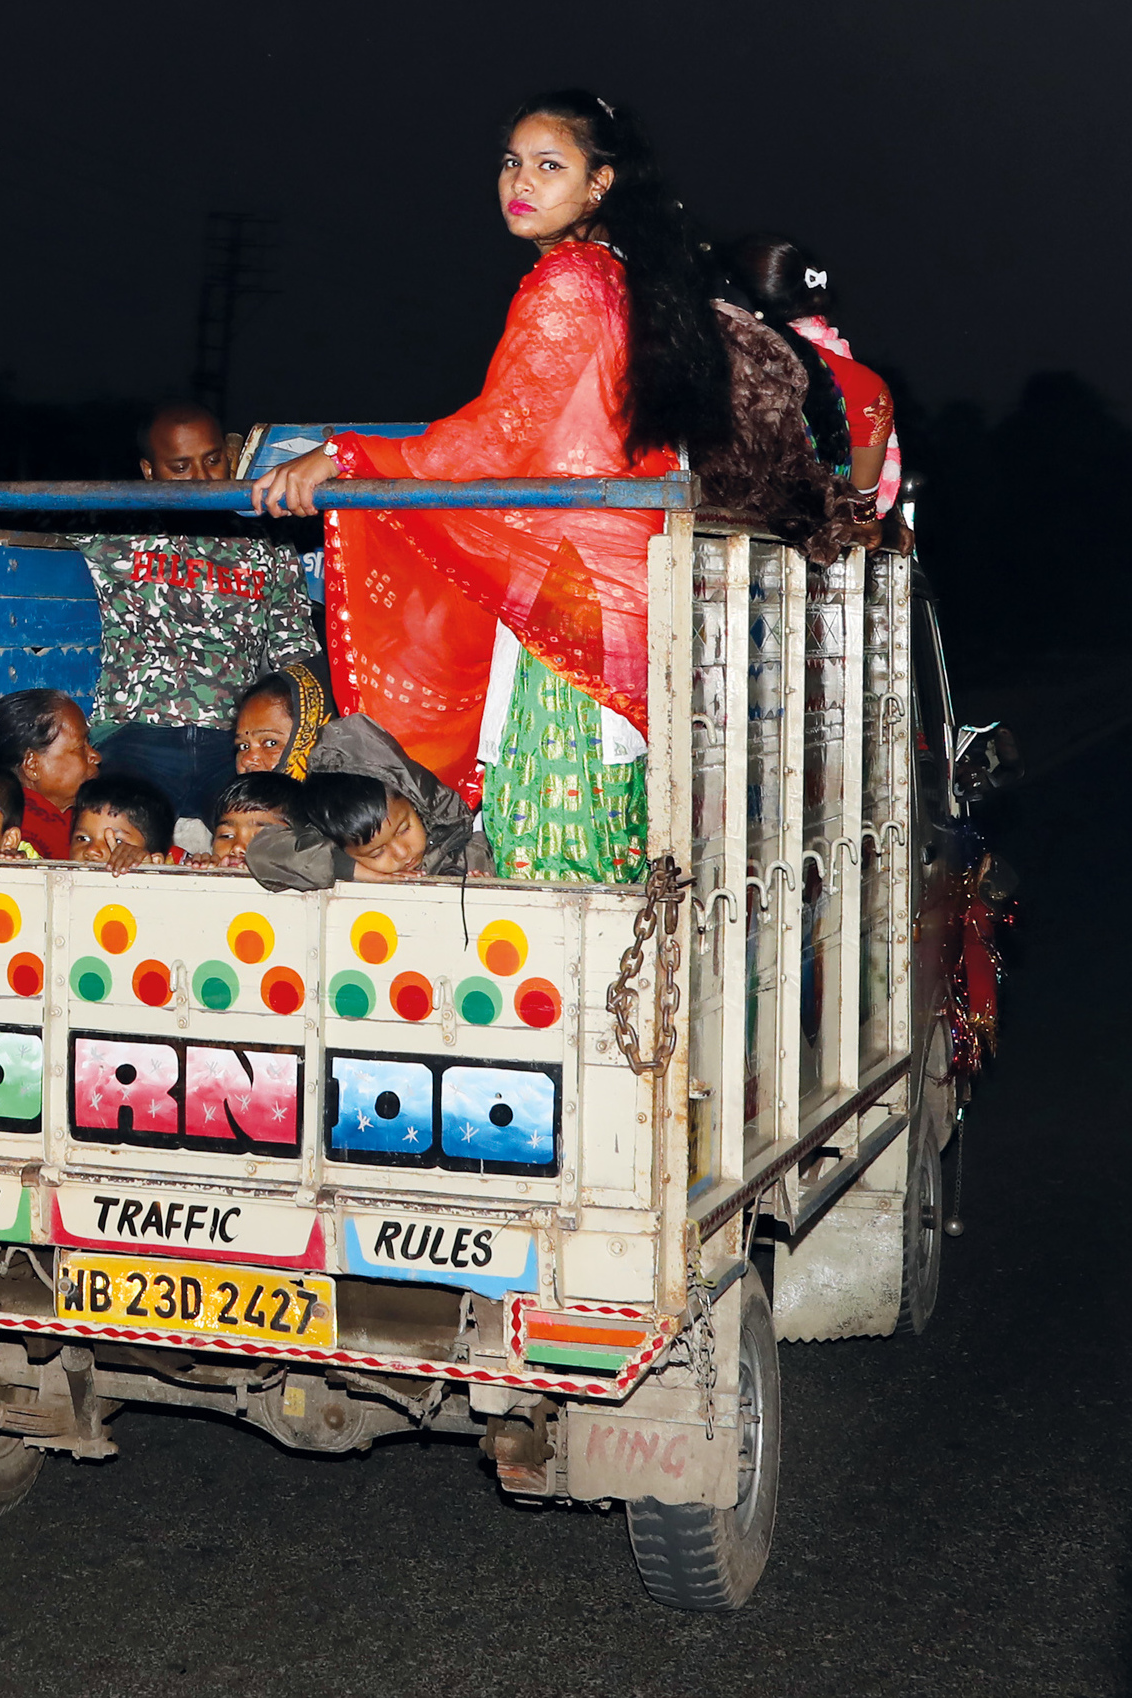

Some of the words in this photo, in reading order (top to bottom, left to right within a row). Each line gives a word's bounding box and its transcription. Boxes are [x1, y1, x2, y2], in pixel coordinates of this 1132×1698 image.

[130, 551, 265, 600] HILFIGER
[331, 1056, 556, 1166] DO
[93, 1196, 241, 1243] TRAFFIC
[374, 1221, 493, 1268] RULES
[62, 1268, 113, 1313] WB
[126, 1272, 203, 1320] 23D
[217, 1281, 318, 1335] 2427
[586, 1423, 689, 1479] KING
